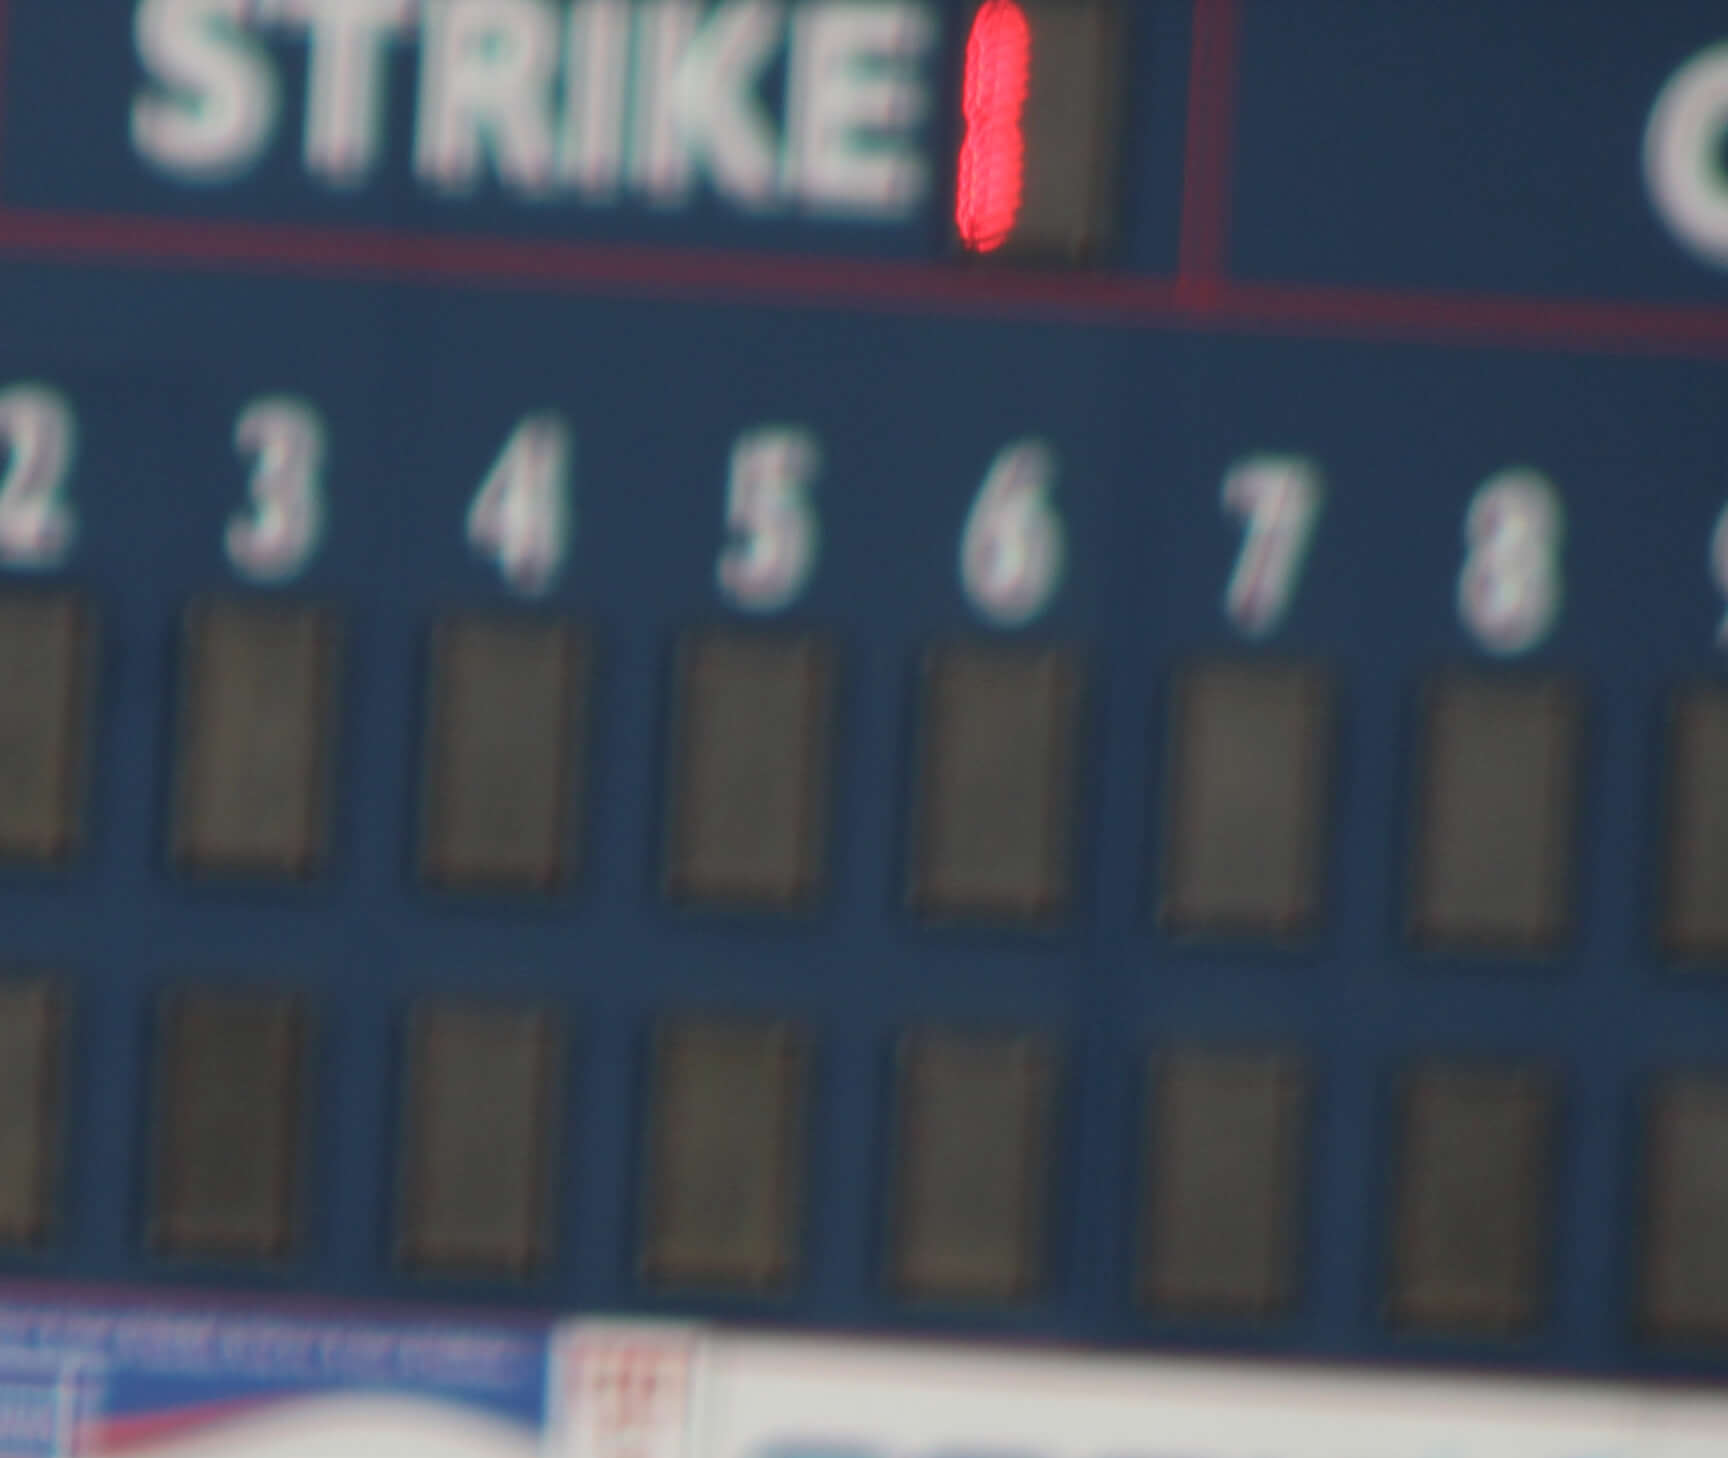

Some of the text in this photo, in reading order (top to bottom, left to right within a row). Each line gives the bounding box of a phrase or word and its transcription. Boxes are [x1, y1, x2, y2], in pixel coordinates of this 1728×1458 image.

[132, 0, 1030, 252] STRIKE 1
[227, 400, 319, 575] 3
[467, 418, 564, 585] 4
[719, 430, 812, 605] 5
[962, 446, 1058, 620] 6
[1224, 459, 1314, 630] 7
[1459, 474, 1556, 648] 8
